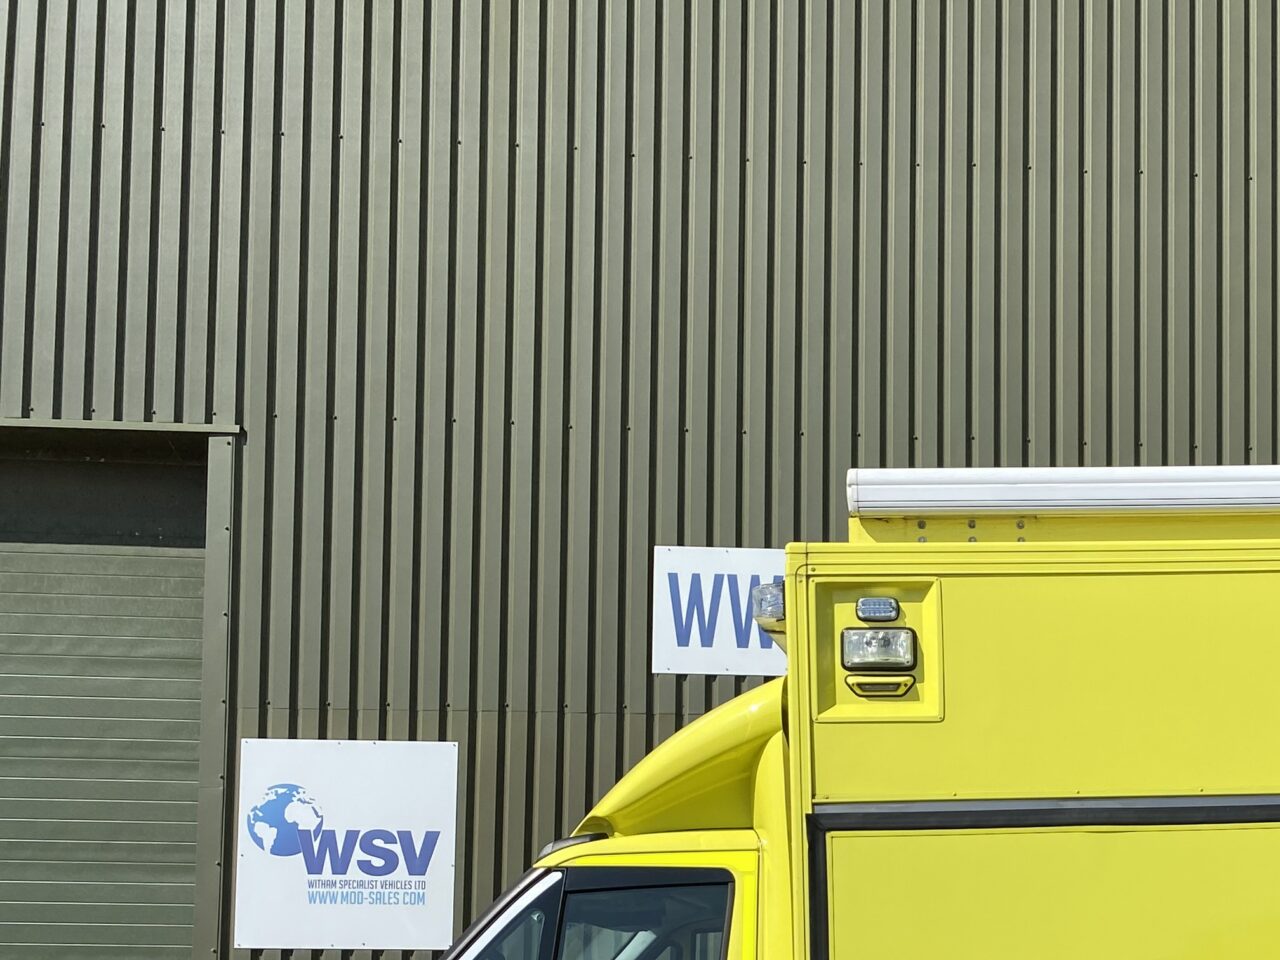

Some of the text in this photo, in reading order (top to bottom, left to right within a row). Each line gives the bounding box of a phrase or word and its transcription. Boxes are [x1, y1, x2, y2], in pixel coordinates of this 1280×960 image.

[297, 829, 441, 877] WSV
[307, 879, 426, 890] WITHAM SPECIALIST VEHICLES LTD
